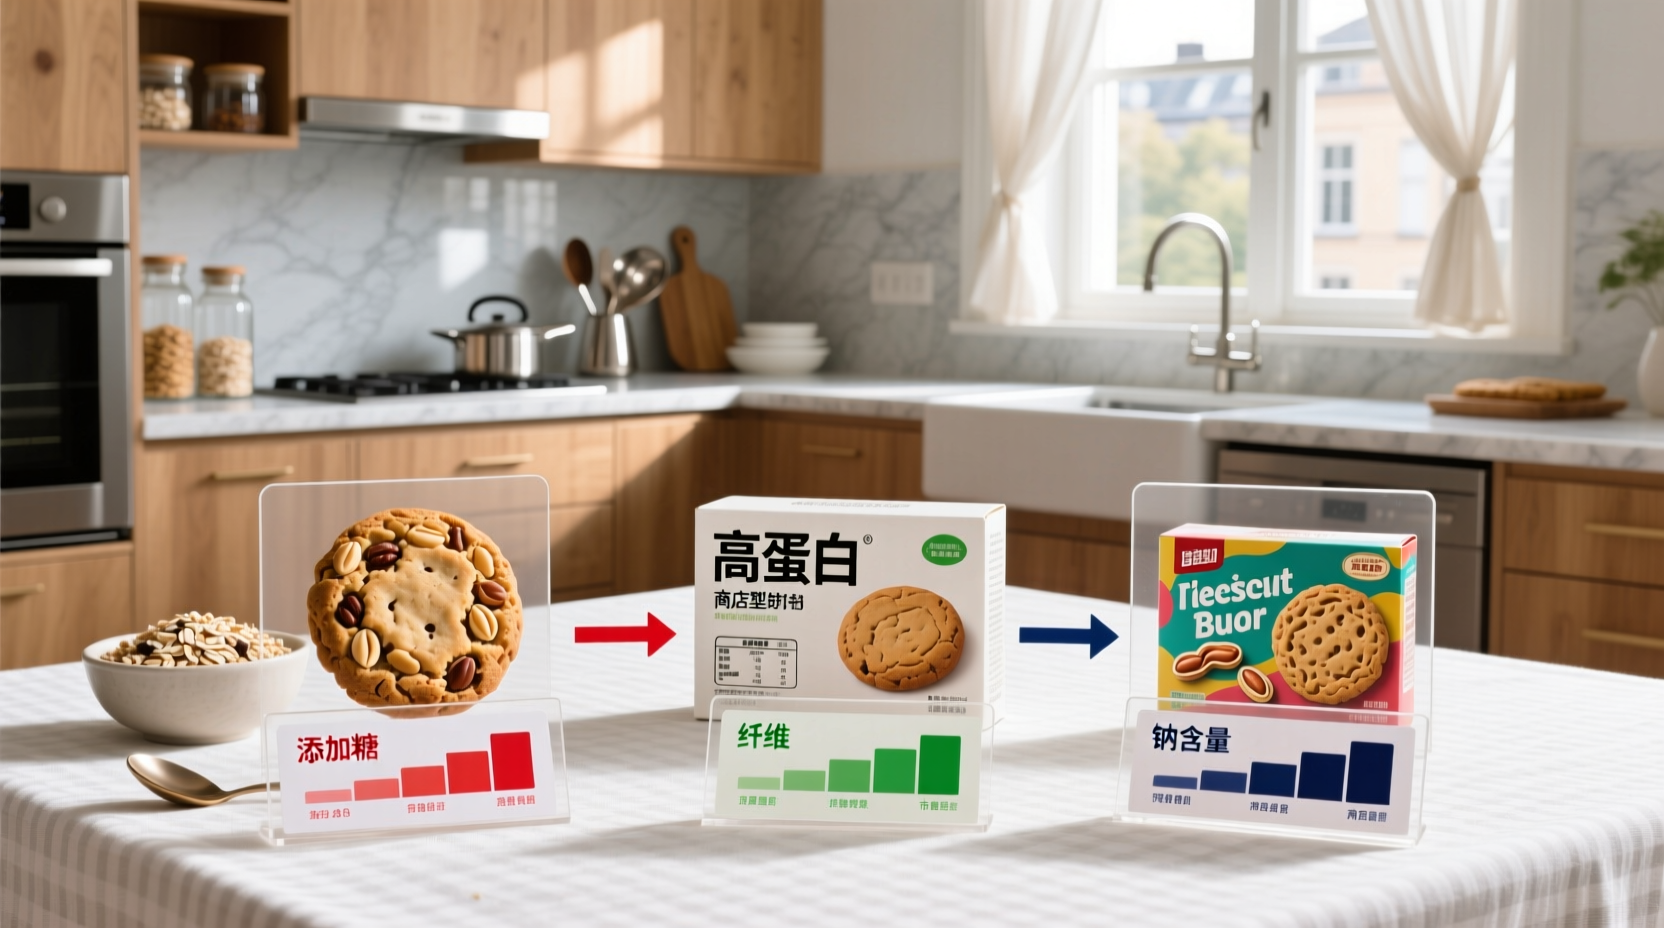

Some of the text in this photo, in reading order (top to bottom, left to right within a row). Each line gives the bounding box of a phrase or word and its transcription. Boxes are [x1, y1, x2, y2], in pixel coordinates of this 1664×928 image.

[713, 529, 858, 587] 高蛋白
[1193, 607, 1268, 640] Buor
[297, 732, 379, 764] 添加糖
[737, 722, 790, 750] 纤维
[1152, 722, 1232, 754] 钠含量
